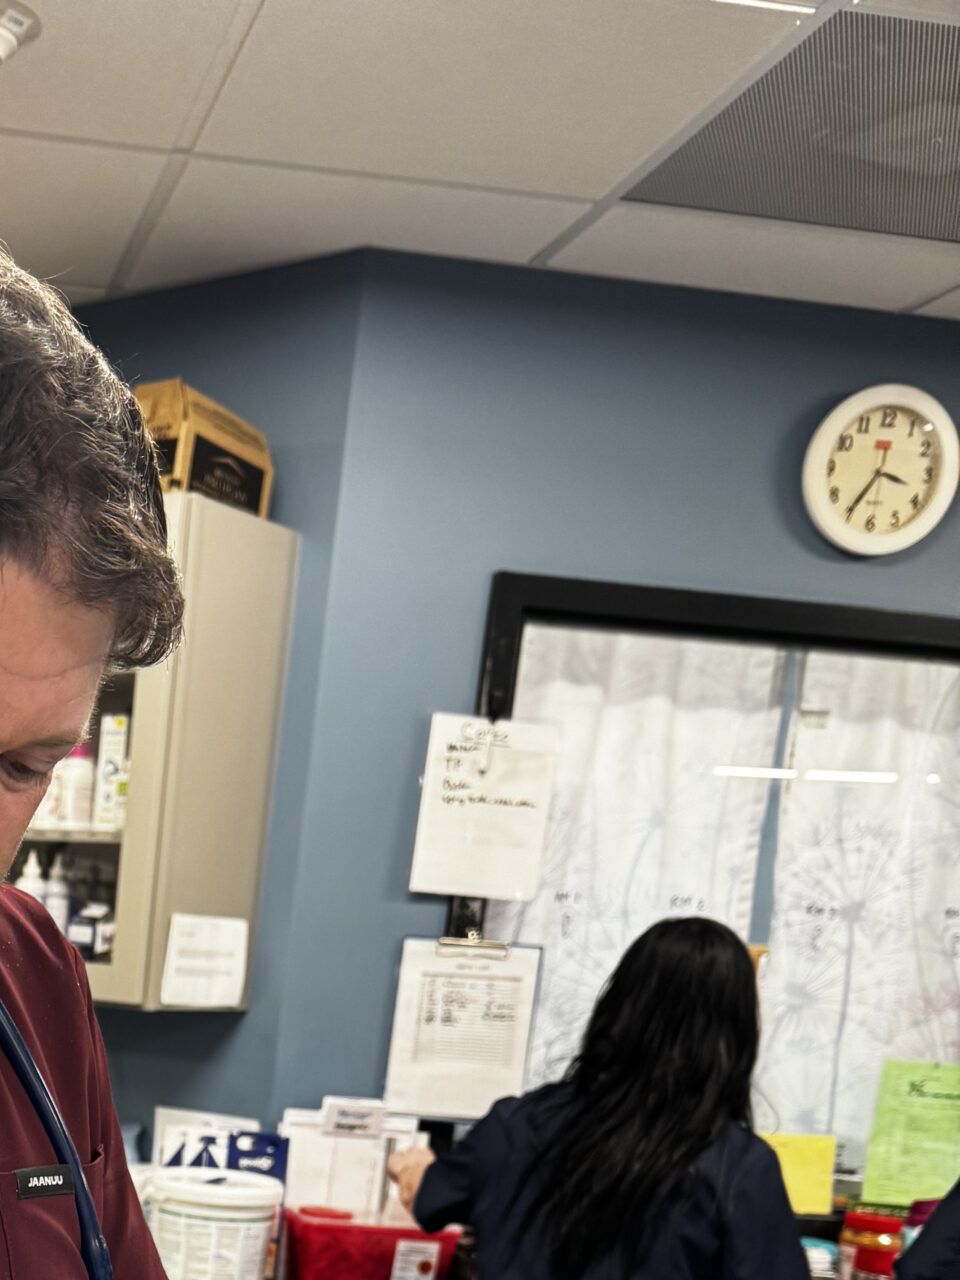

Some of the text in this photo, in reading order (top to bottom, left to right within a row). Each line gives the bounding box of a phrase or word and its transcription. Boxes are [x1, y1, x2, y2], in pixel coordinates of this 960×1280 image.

[857, 416, 870, 434] 11
[880, 409, 897, 428] 12
[908, 419, 916, 438] 1
[838, 433, 854, 452] 10
[920, 440, 931, 458] 2
[827, 458, 836, 478] 9
[924, 467, 933, 484] 3
[829, 486, 840, 504] 8
[910, 493, 919, 510] 4
[865, 514, 876, 533] 6
[890, 510, 900, 528] 5
[28, 1175, 64, 1188] JAANUU
